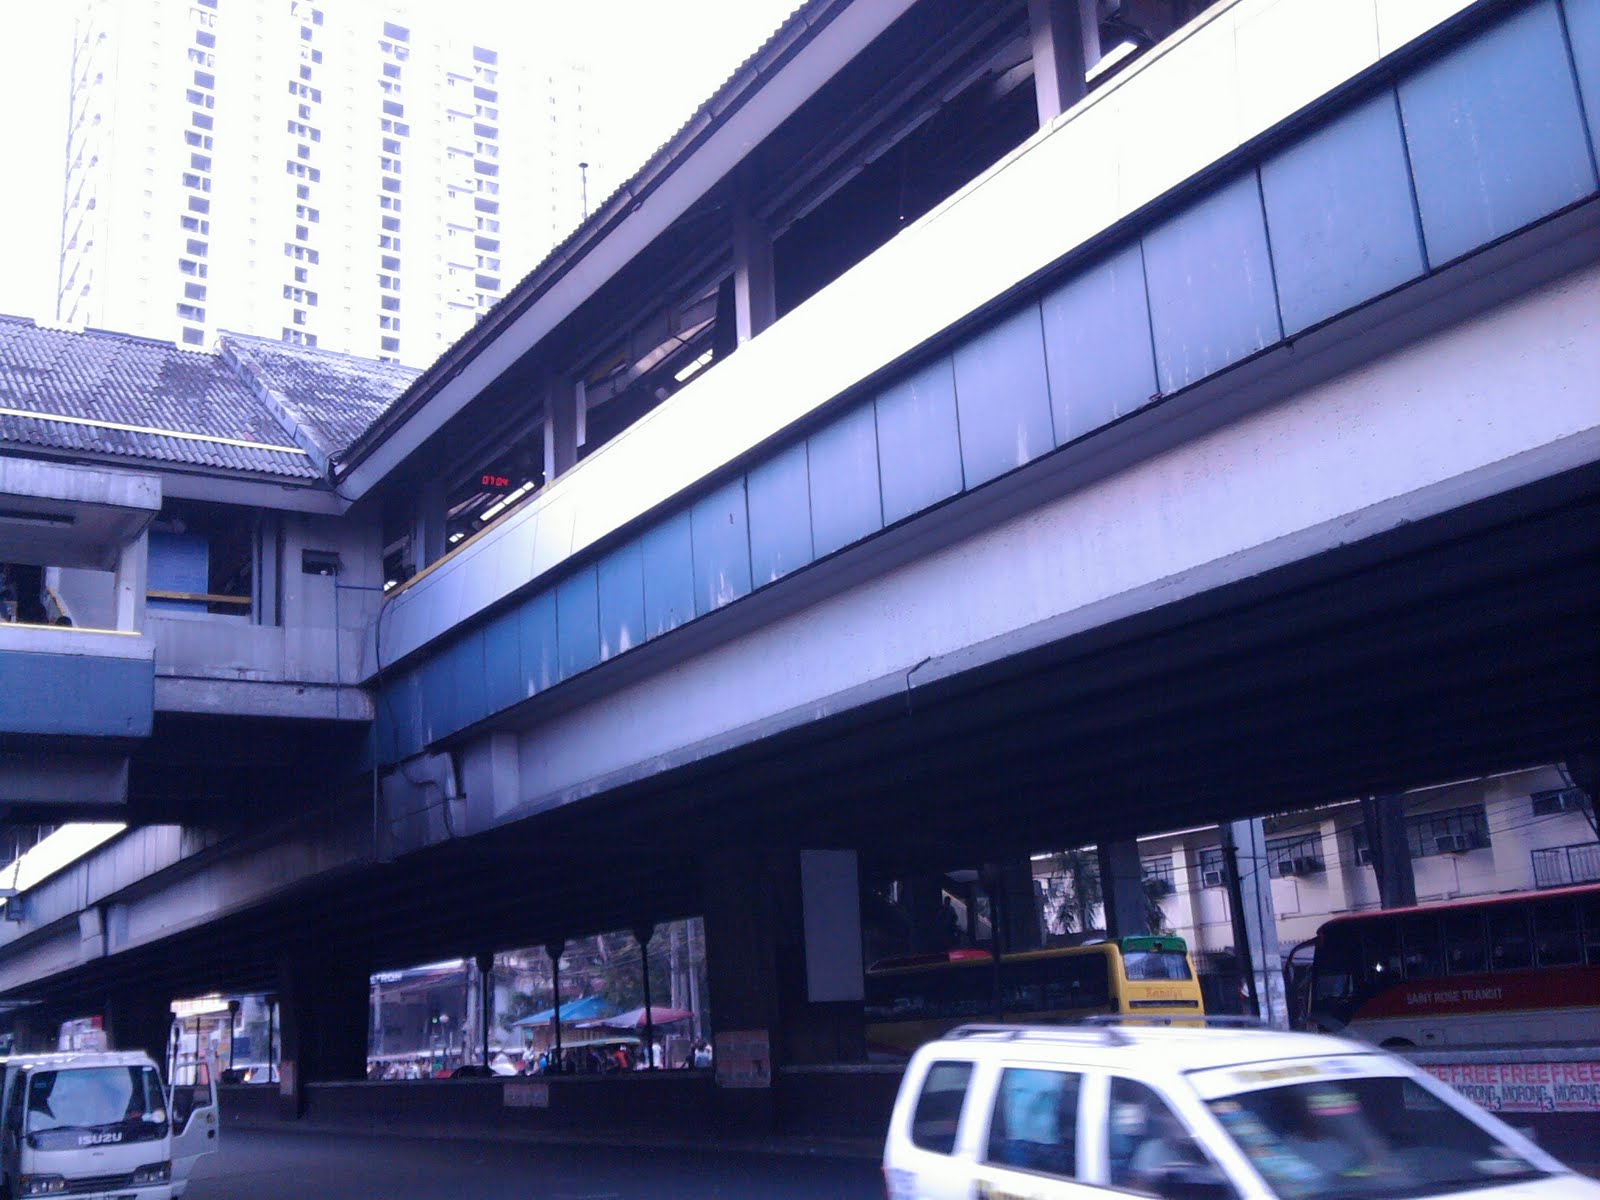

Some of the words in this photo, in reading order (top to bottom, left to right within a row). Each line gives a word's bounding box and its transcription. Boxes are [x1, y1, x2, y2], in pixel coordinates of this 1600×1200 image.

[1462, 986, 1503, 1001] TRANSIT
[1451, 1064, 1499, 1083] FREE
[1501, 1063, 1550, 1083] FREE
[1551, 1062, 1600, 1083] FREE
[78, 1132, 123, 1146] ISUZU
